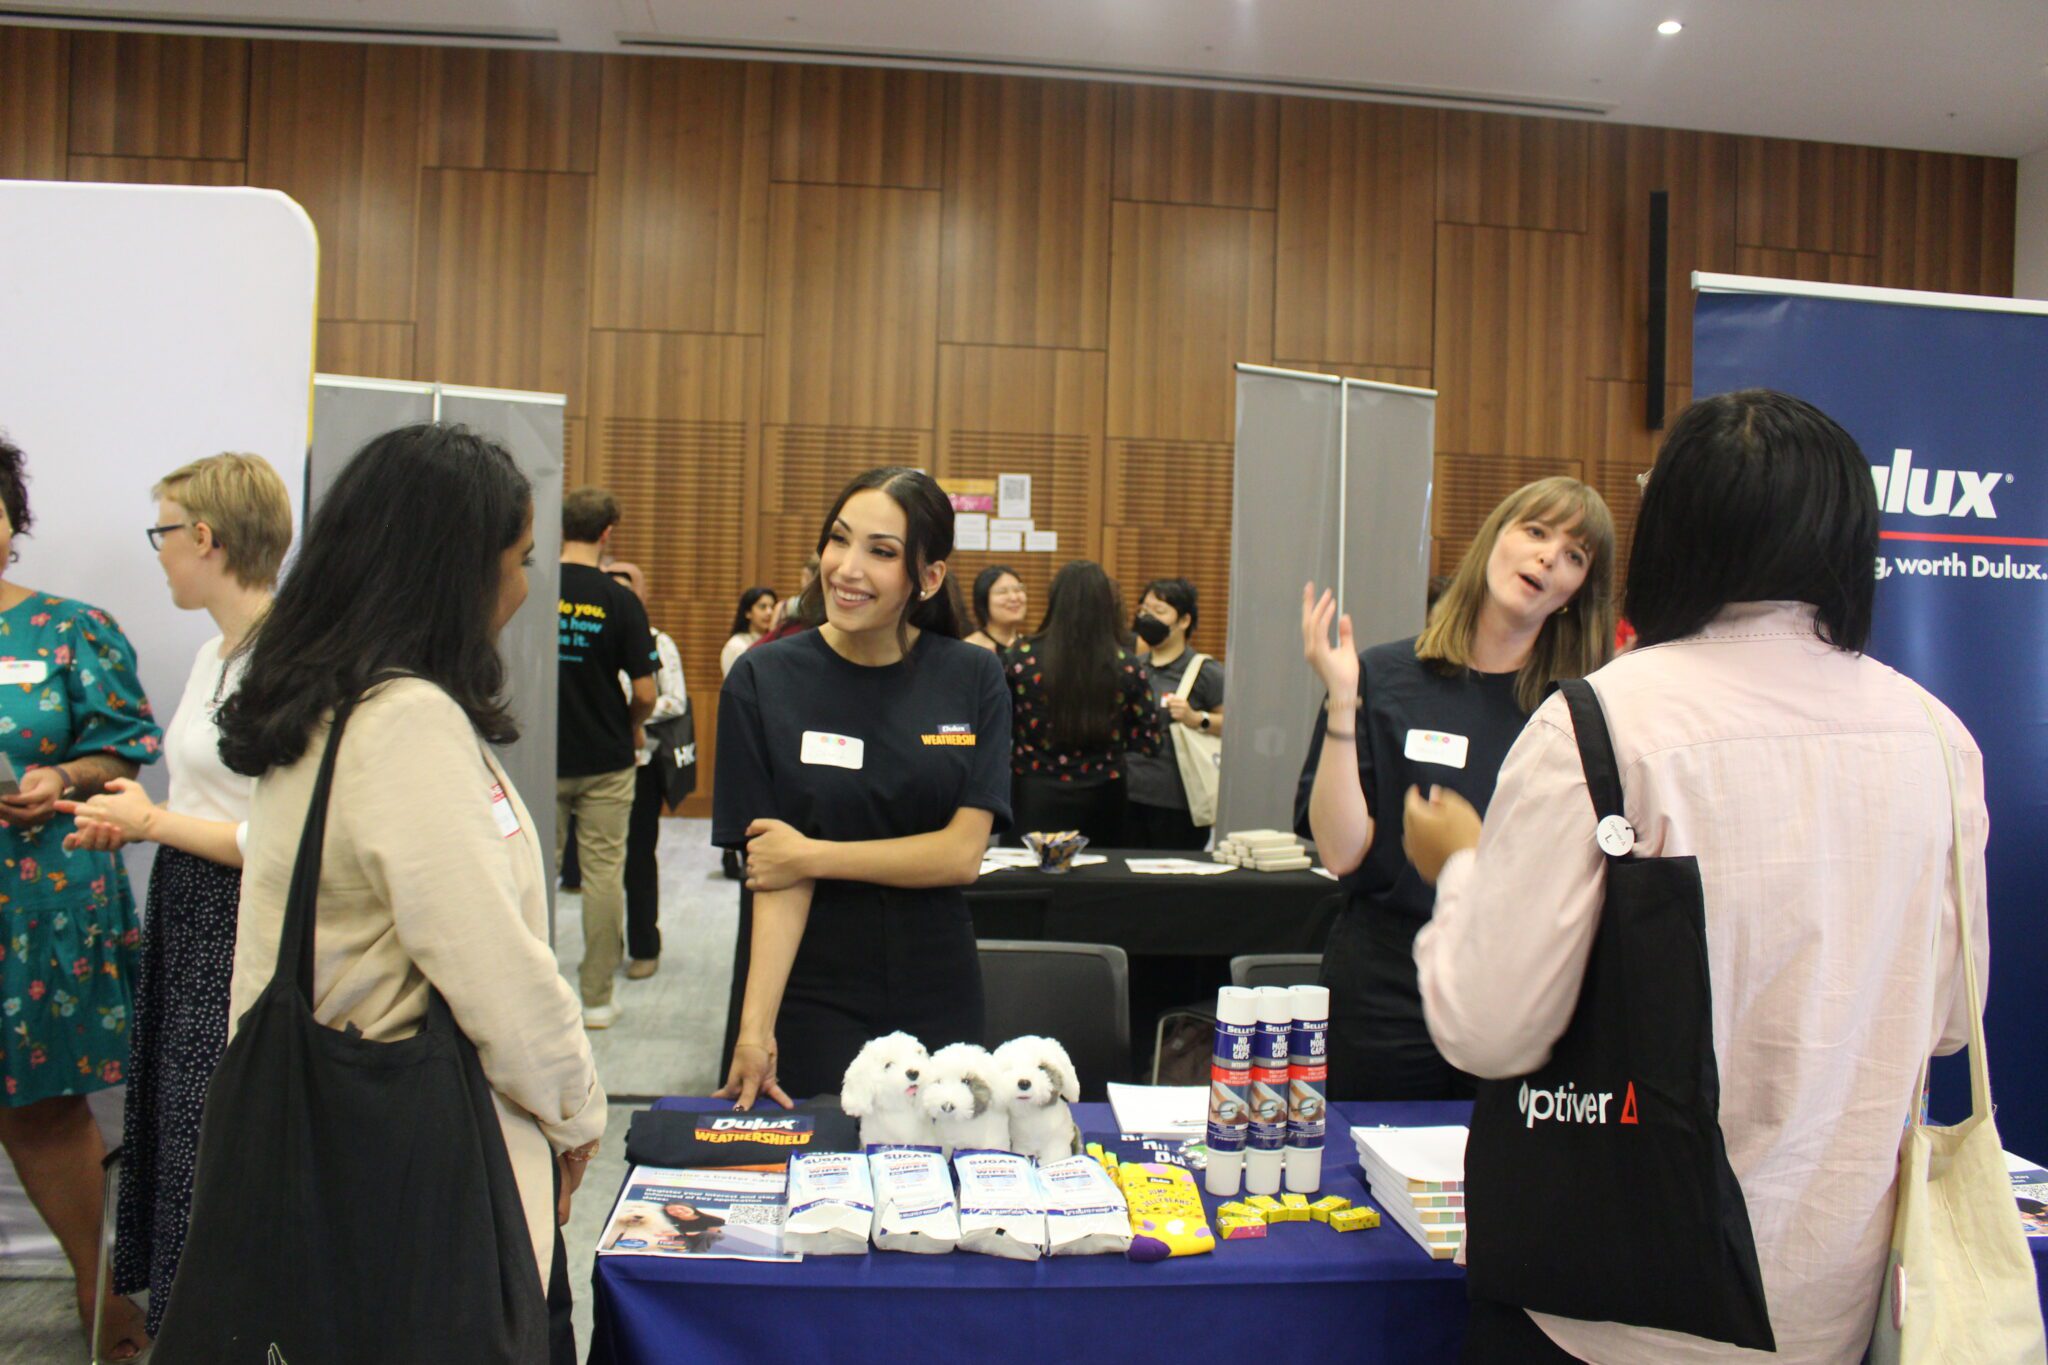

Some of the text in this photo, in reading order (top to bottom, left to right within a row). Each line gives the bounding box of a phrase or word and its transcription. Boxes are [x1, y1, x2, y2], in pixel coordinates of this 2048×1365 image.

[1870, 448, 2004, 519] lux
[1895, 552, 1967, 577] worth
[1972, 554, 2048, 581] Dulux.
[575, 602, 606, 618] you.
[570, 617, 602, 634] how
[1238, 1036, 1248, 1044] NO
[1277, 1034, 1286, 1042] NO
[1233, 1043, 1250, 1052] MORE
[1272, 1041, 1288, 1050] MORE
[1310, 1038, 1325, 1048] MORE
[1233, 1051, 1249, 1060] GAPS
[1272, 1049, 1287, 1058] GAPS
[1310, 1047, 1325, 1055] GAPS
[712, 1118, 797, 1130] Dulux
[695, 1130, 812, 1146] WEATHERSHIELD
[803, 1156, 852, 1164] SUGAR
